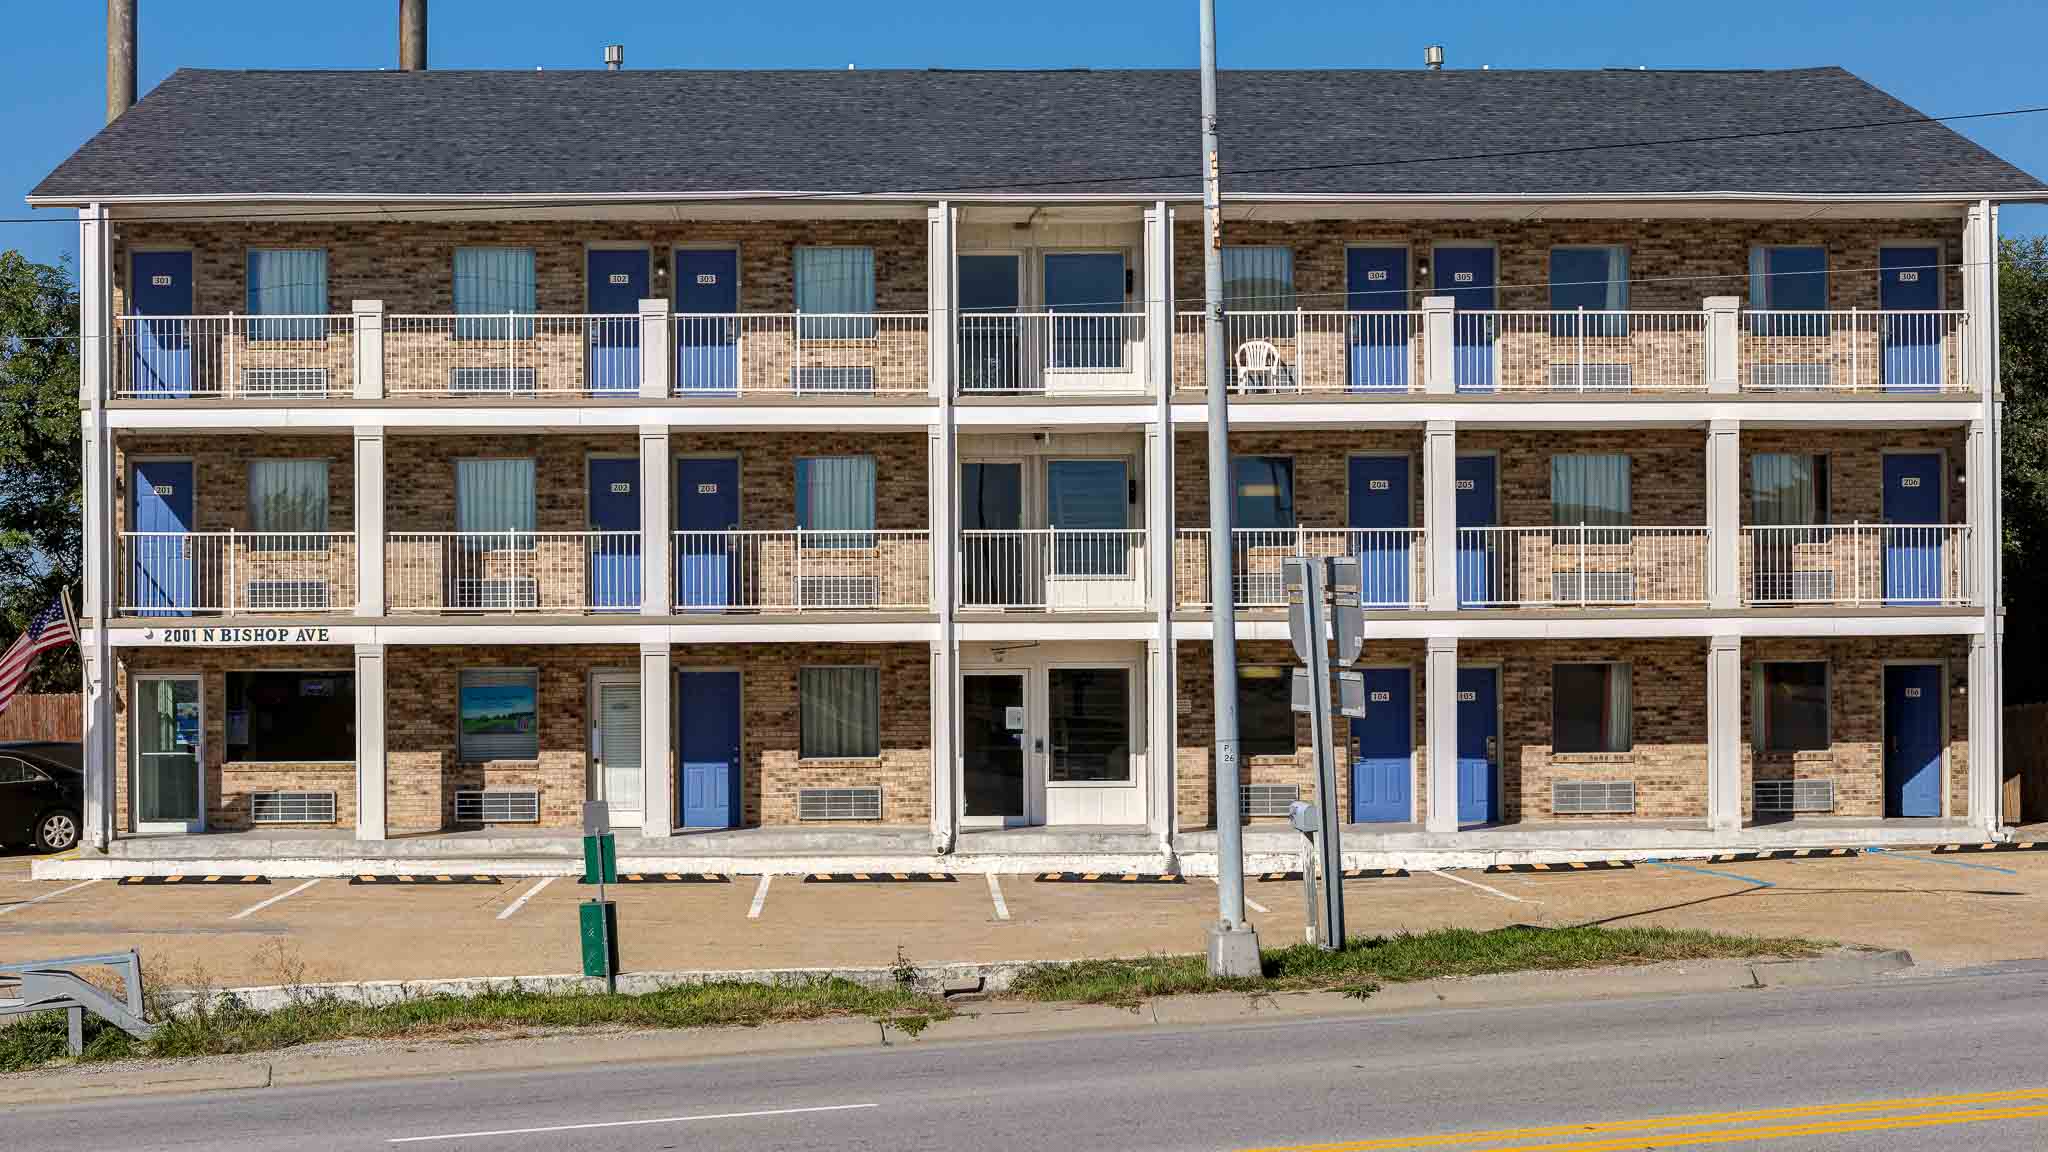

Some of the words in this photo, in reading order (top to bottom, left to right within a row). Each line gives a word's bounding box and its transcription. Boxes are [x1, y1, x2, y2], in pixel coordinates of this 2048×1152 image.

[612, 275, 627, 283] 302
[698, 275, 714, 283] 303
[1369, 272, 1385, 280] 304
[1456, 273, 1471, 281] 305
[1902, 272, 1917, 281] 306
[154, 277, 170, 285] 301
[1371, 480, 1387, 489] 204
[1457, 480, 1472, 489] 205
[1904, 478, 1918, 487] 206
[156, 486, 171, 494] 201
[613, 484, 628, 492] 202
[700, 484, 715, 493] 203
[164, 628, 197, 642] 2001
[203, 628, 215, 642] N
[220, 628, 289, 642] BISHOP
[295, 628, 329, 642] AVE
